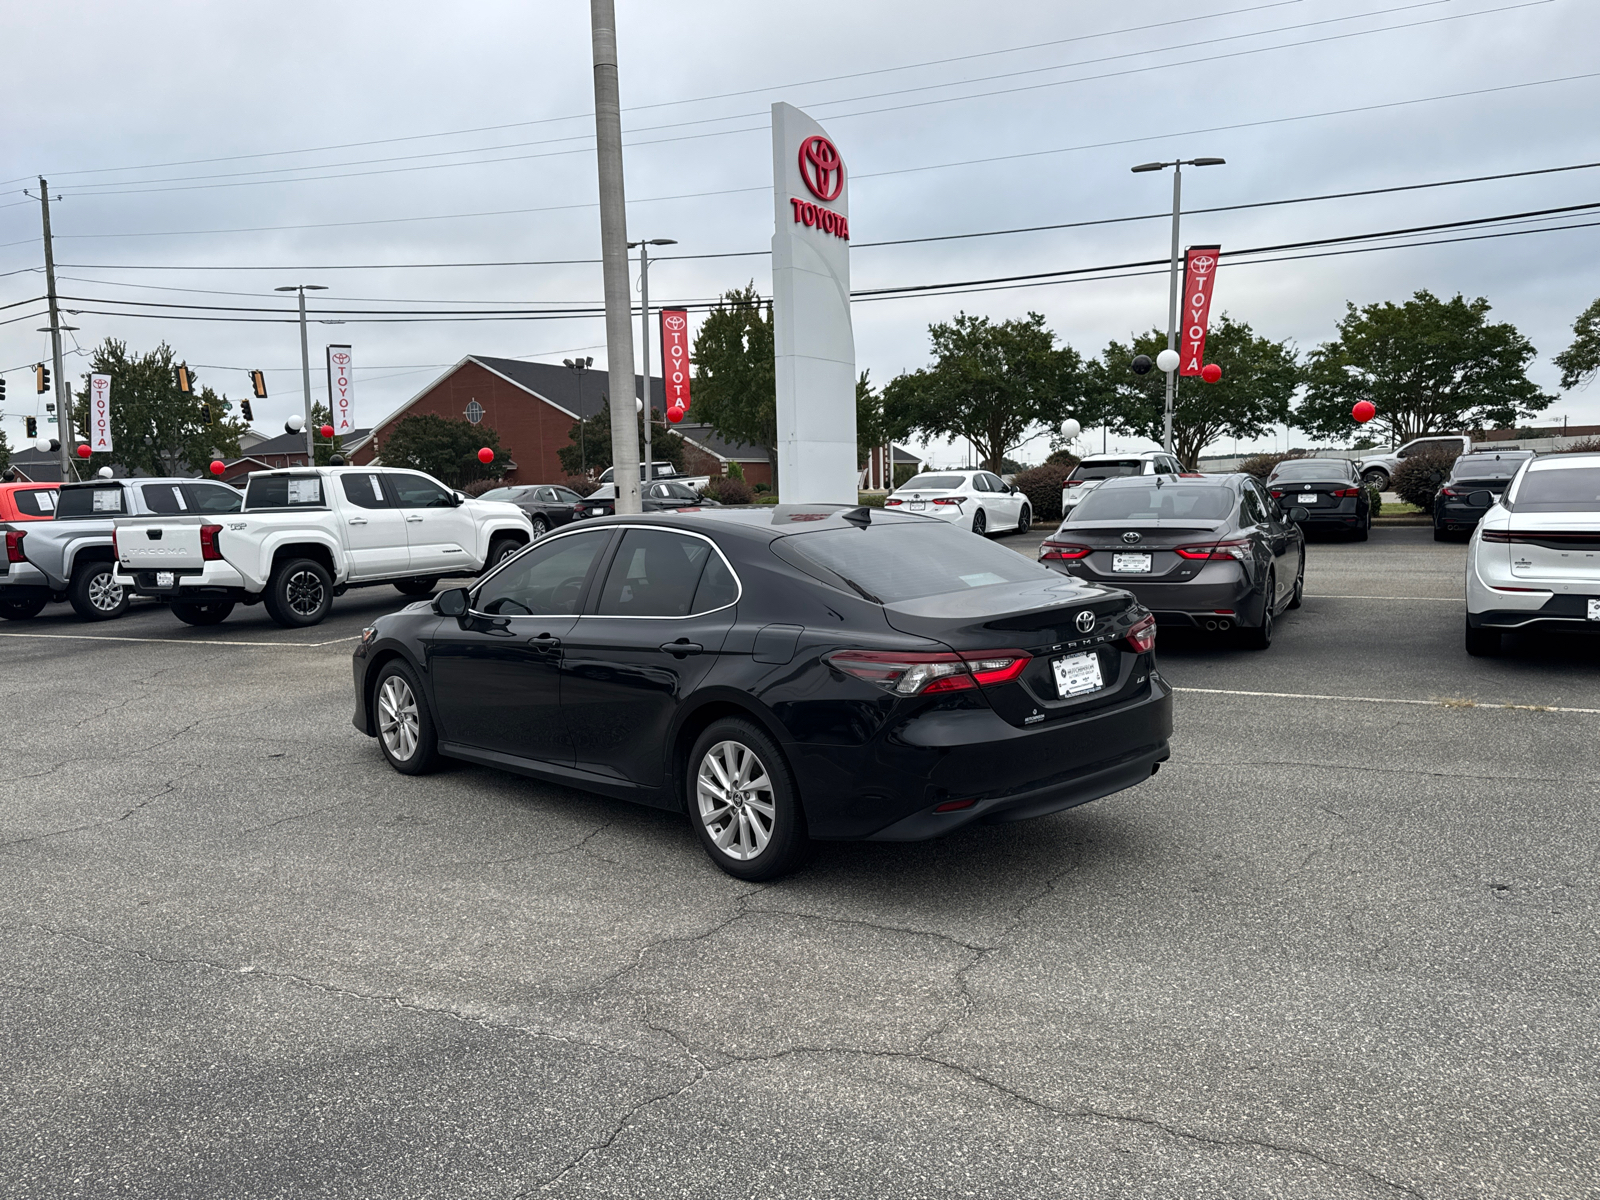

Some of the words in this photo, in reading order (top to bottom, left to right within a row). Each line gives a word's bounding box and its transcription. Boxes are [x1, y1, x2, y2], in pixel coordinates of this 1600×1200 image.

[790, 198, 850, 241] TOYOTA
[1187, 276, 1207, 371] TOYOTA
[671, 332, 686, 409] TOYOTA
[96, 390, 107, 447] TOYOTA
[338, 366, 349, 429] TOYOTA
[129, 547, 188, 556] TACOMA
[1052, 633, 1116, 651] CAMRY
[1136, 675, 1146, 684] LE
